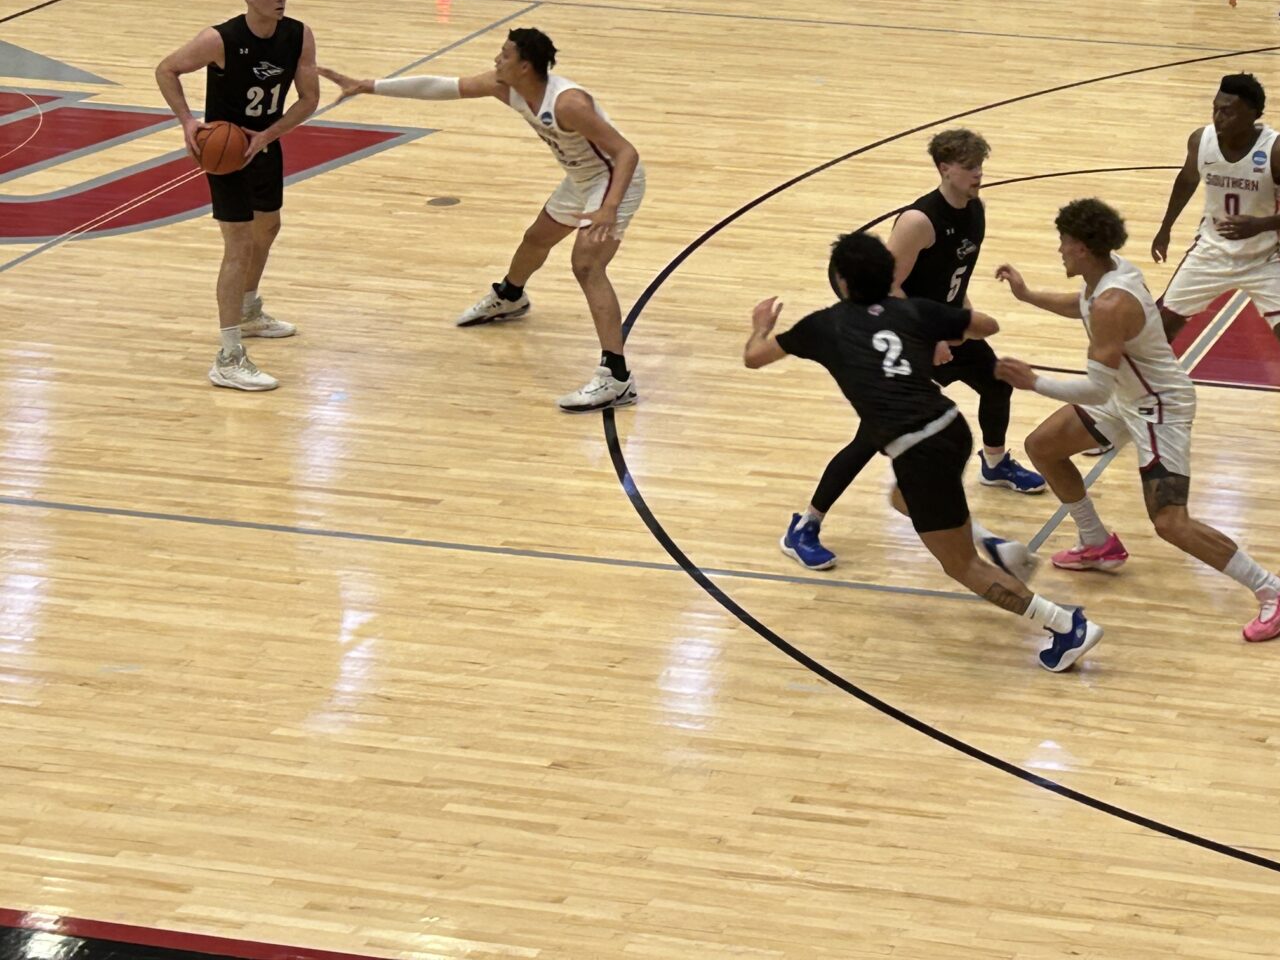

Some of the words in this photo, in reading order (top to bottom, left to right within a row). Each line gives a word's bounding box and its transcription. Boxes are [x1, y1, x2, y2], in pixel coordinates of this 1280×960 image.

[244, 83, 281, 117] 21
[1205, 172, 1259, 192] SOUTHERN
[1224, 192, 1240, 216] 0
[945, 265, 968, 303] 5
[872, 329, 912, 378] 2
